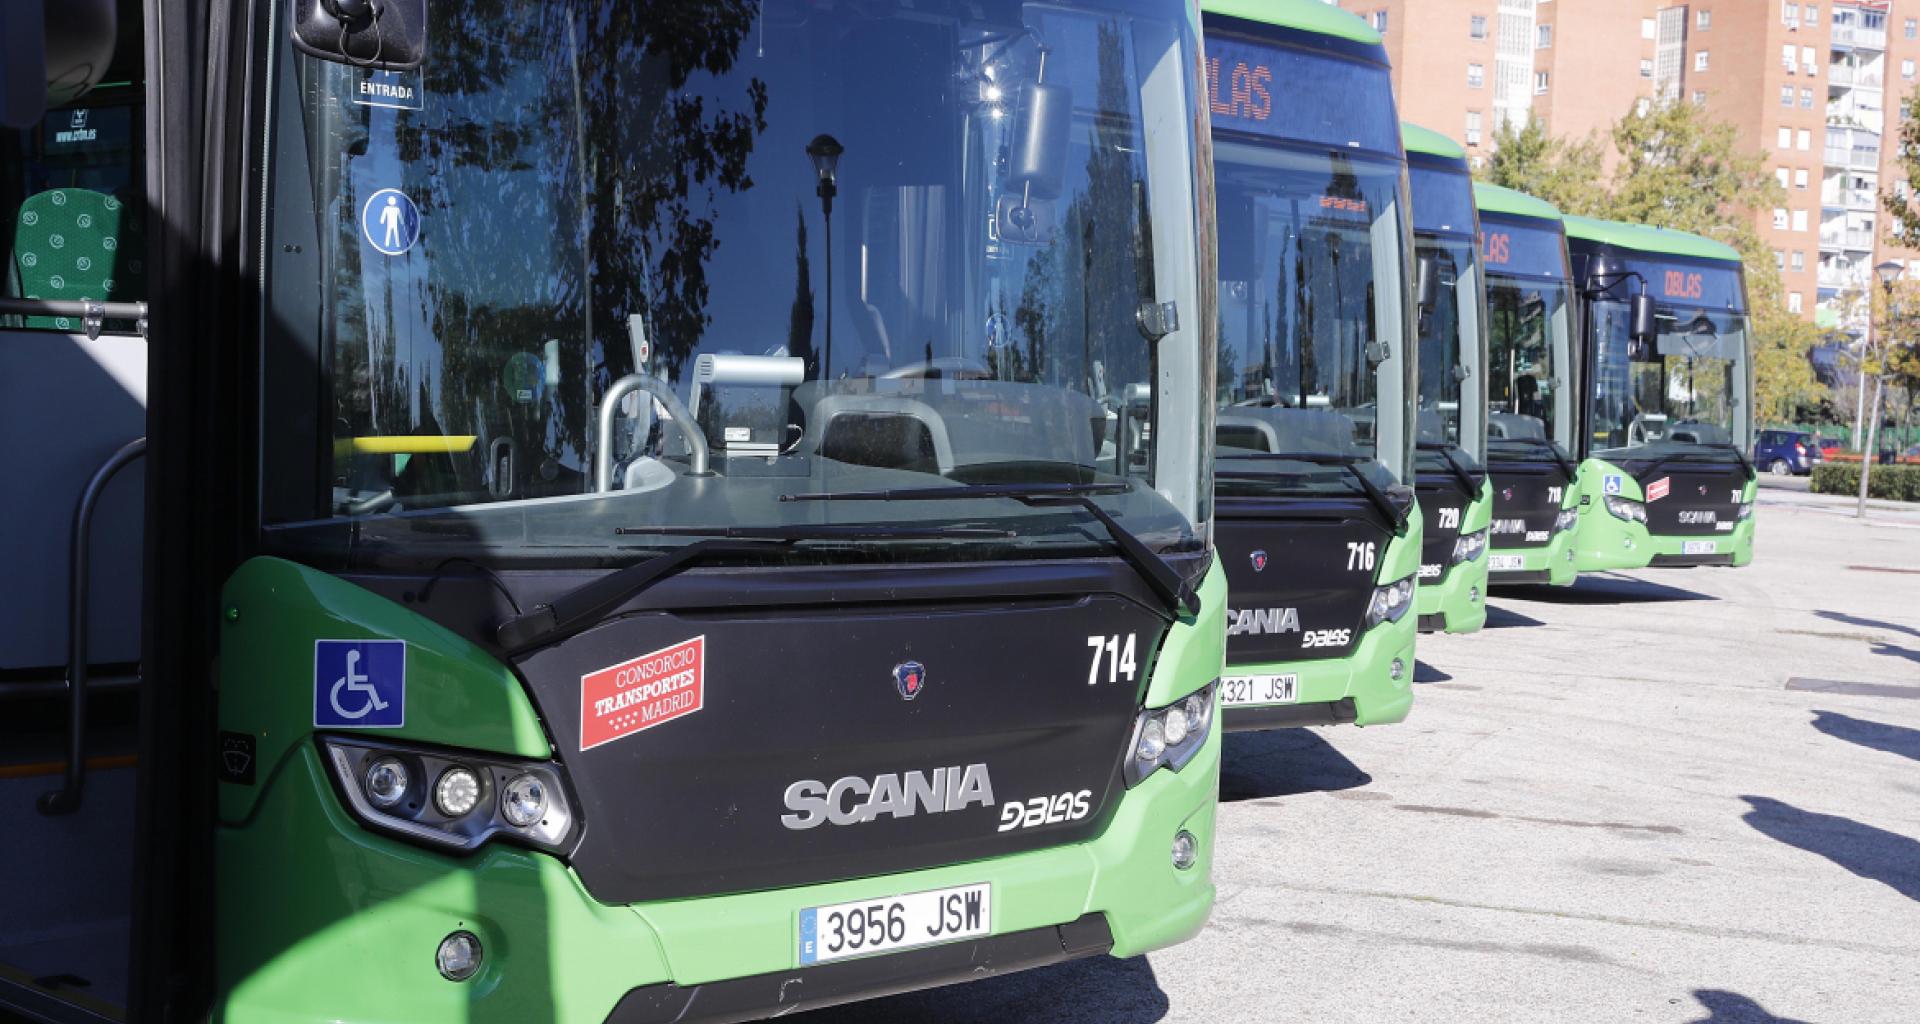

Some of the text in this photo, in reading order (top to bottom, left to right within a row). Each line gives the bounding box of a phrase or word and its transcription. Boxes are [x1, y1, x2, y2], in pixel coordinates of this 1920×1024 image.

[360, 81, 414, 100] ENTRADA
[1204, 57, 1272, 119] LAS
[1481, 232, 1509, 264] LAS
[1664, 270, 1703, 299] DBLAS
[1438, 507, 1460, 529] 720
[1490, 519, 1527, 534] CANIA
[1678, 510, 1716, 523] SCANIA
[1347, 542, 1375, 571] 716
[1418, 563, 1442, 577] BLAS
[1227, 607, 1300, 635] CANIA
[616, 647, 695, 688] CONSORCIO
[1087, 633, 1136, 685] 714
[595, 669, 695, 717] TRANSPORTES
[1265, 676, 1294, 700] JSW
[641, 690, 694, 722] MADRID
[780, 763, 995, 830] SCANIA
[827, 902, 905, 953] 3956
[926, 890, 982, 937] JSW
